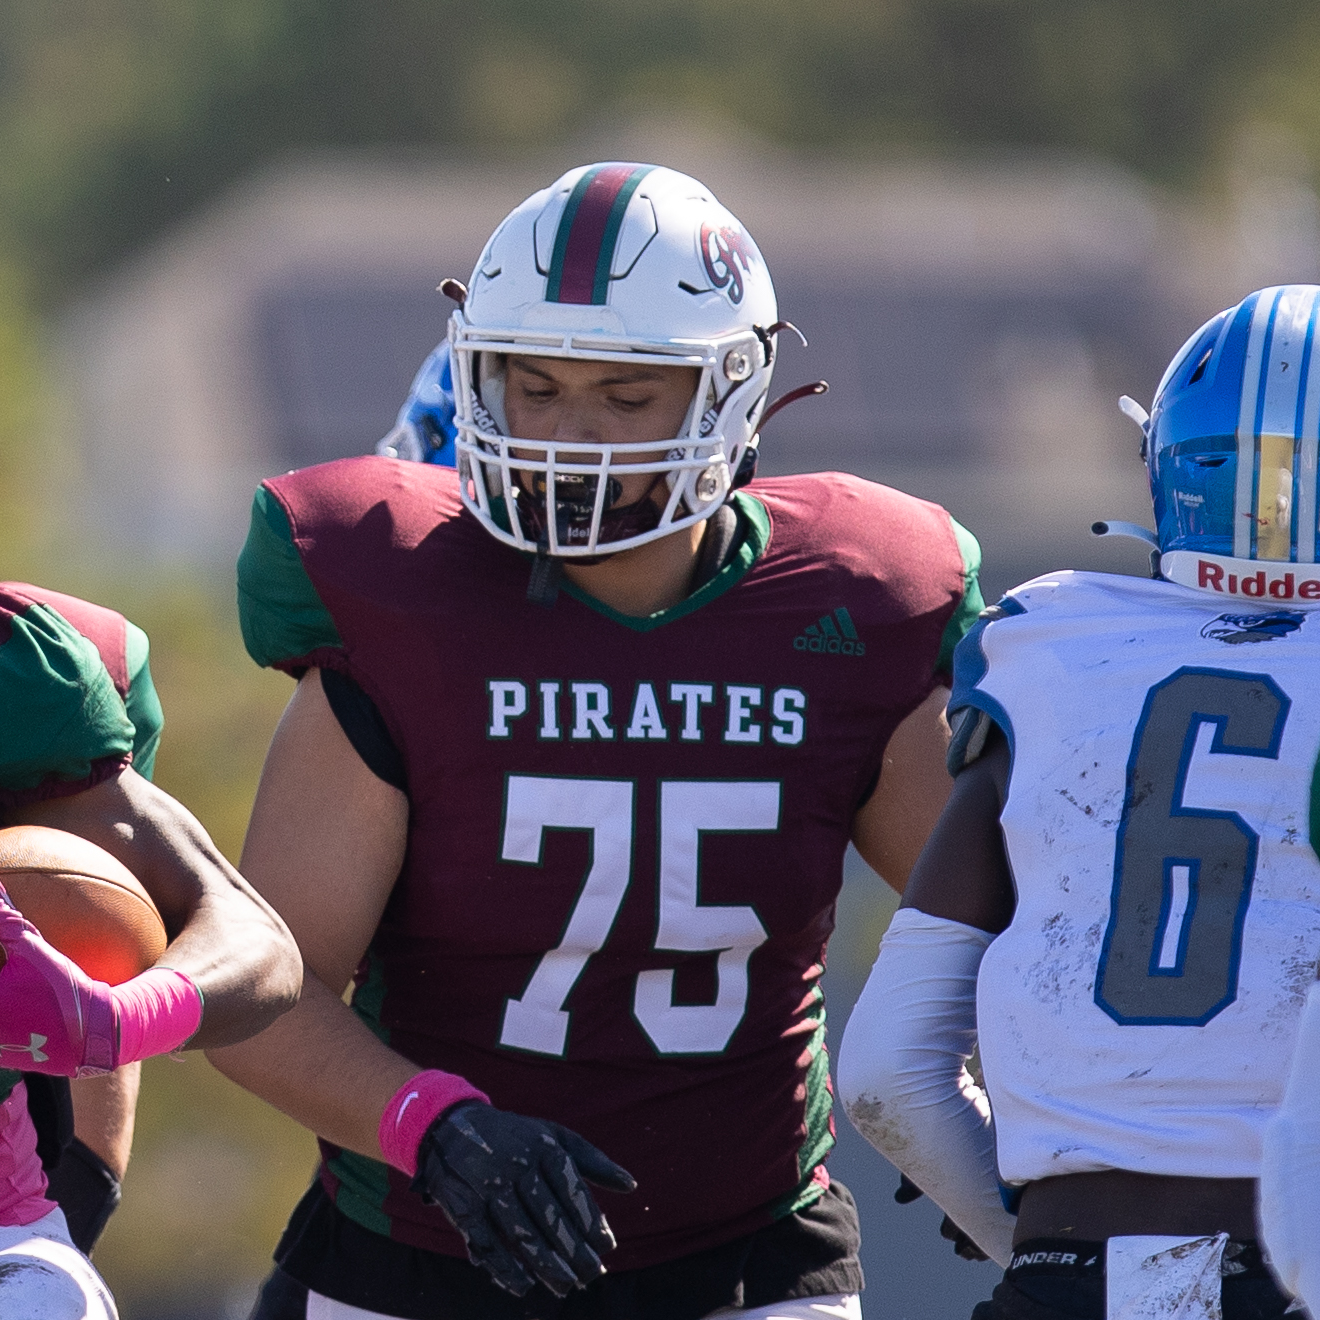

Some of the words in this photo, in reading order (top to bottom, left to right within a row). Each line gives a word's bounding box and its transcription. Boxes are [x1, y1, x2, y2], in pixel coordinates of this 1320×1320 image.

[1197, 559, 1320, 600] Ridde
[793, 634, 866, 657] adidas
[487, 679, 808, 746] PIRATES
[1093, 664, 1293, 1027] 6
[498, 774, 782, 1058] 75
[1012, 1251, 1078, 1270] UNDER
